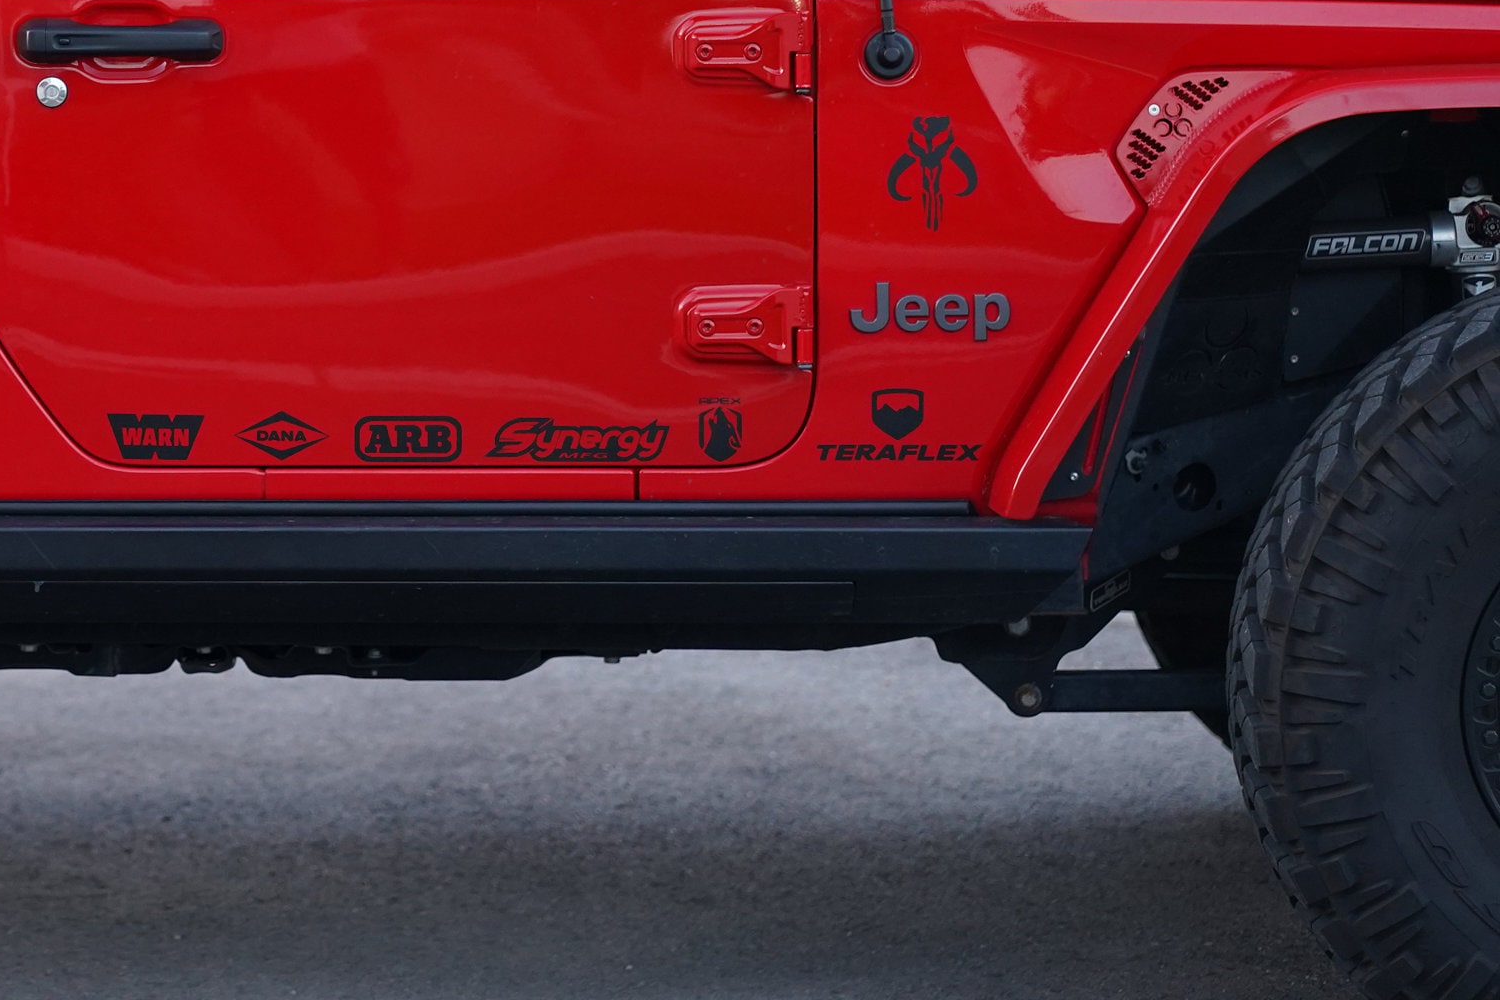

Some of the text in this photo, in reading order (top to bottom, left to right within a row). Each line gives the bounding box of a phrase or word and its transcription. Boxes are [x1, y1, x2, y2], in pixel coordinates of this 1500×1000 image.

[1311, 231, 1419, 257] FALCON
[850, 282, 1011, 341] Jeep
[122, 427, 190, 447] WARN
[256, 429, 307, 442] DANA
[364, 424, 453, 454] ARB
[492, 419, 667, 460] Synergy
[557, 451, 610, 460] MFG
[816, 444, 982, 462] TERAFLEX
